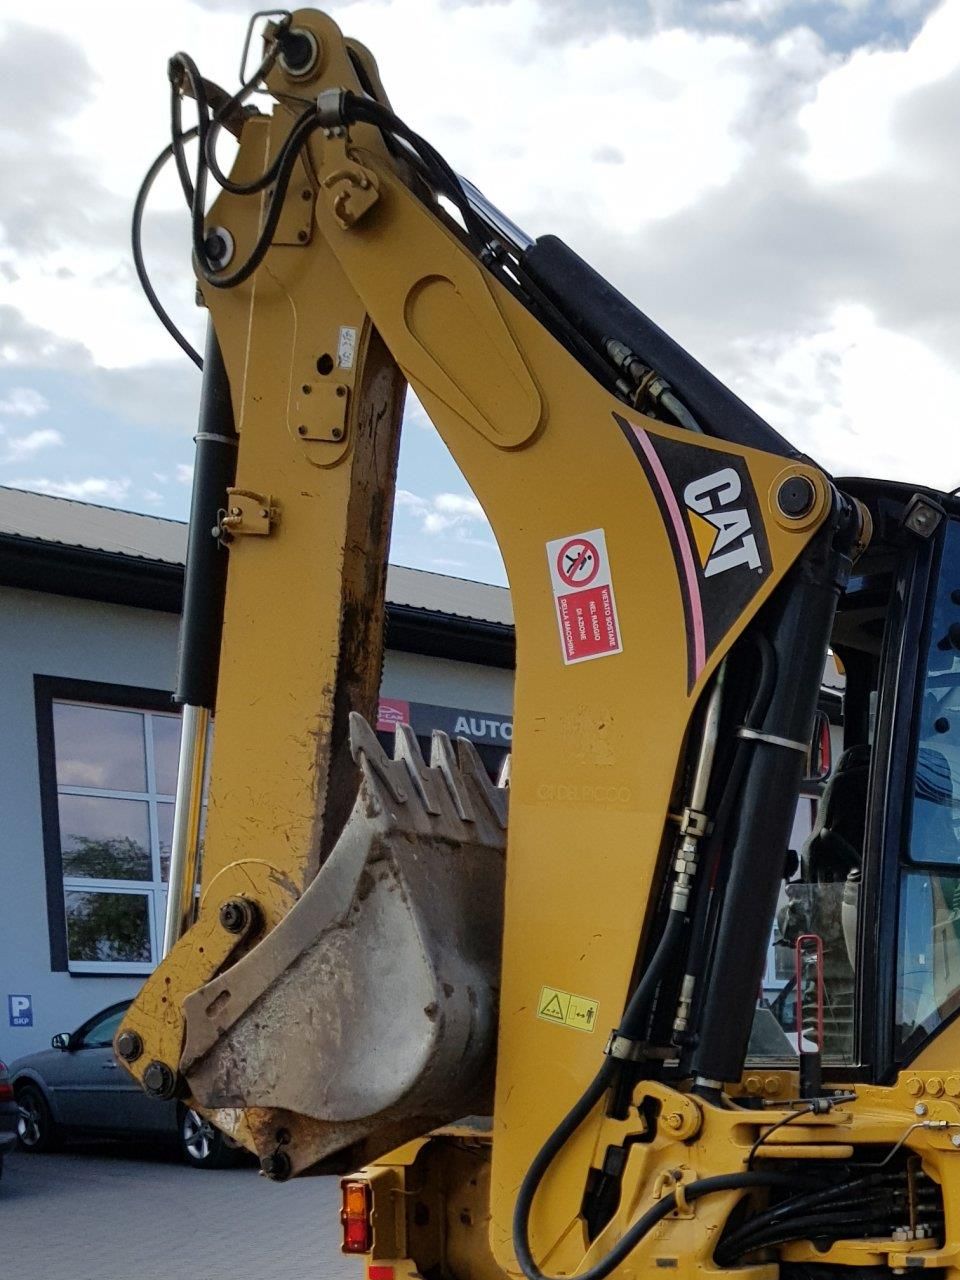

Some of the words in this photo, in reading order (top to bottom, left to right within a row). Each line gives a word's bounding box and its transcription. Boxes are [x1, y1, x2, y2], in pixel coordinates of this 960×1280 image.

[684, 467, 762, 578] CAT
[576, 608, 583, 616] DI
[602, 589, 611, 616] VIETATO
[561, 598, 569, 620] DELLA
[565, 621, 575, 656] MACCHINA
[578, 616, 587, 641] AZIONE
[591, 615, 600, 641] RAGGIO
[606, 616, 616, 647] SOSTARE
[454, 716, 513, 740] AUTO
[12, 996, 30, 1017] P
